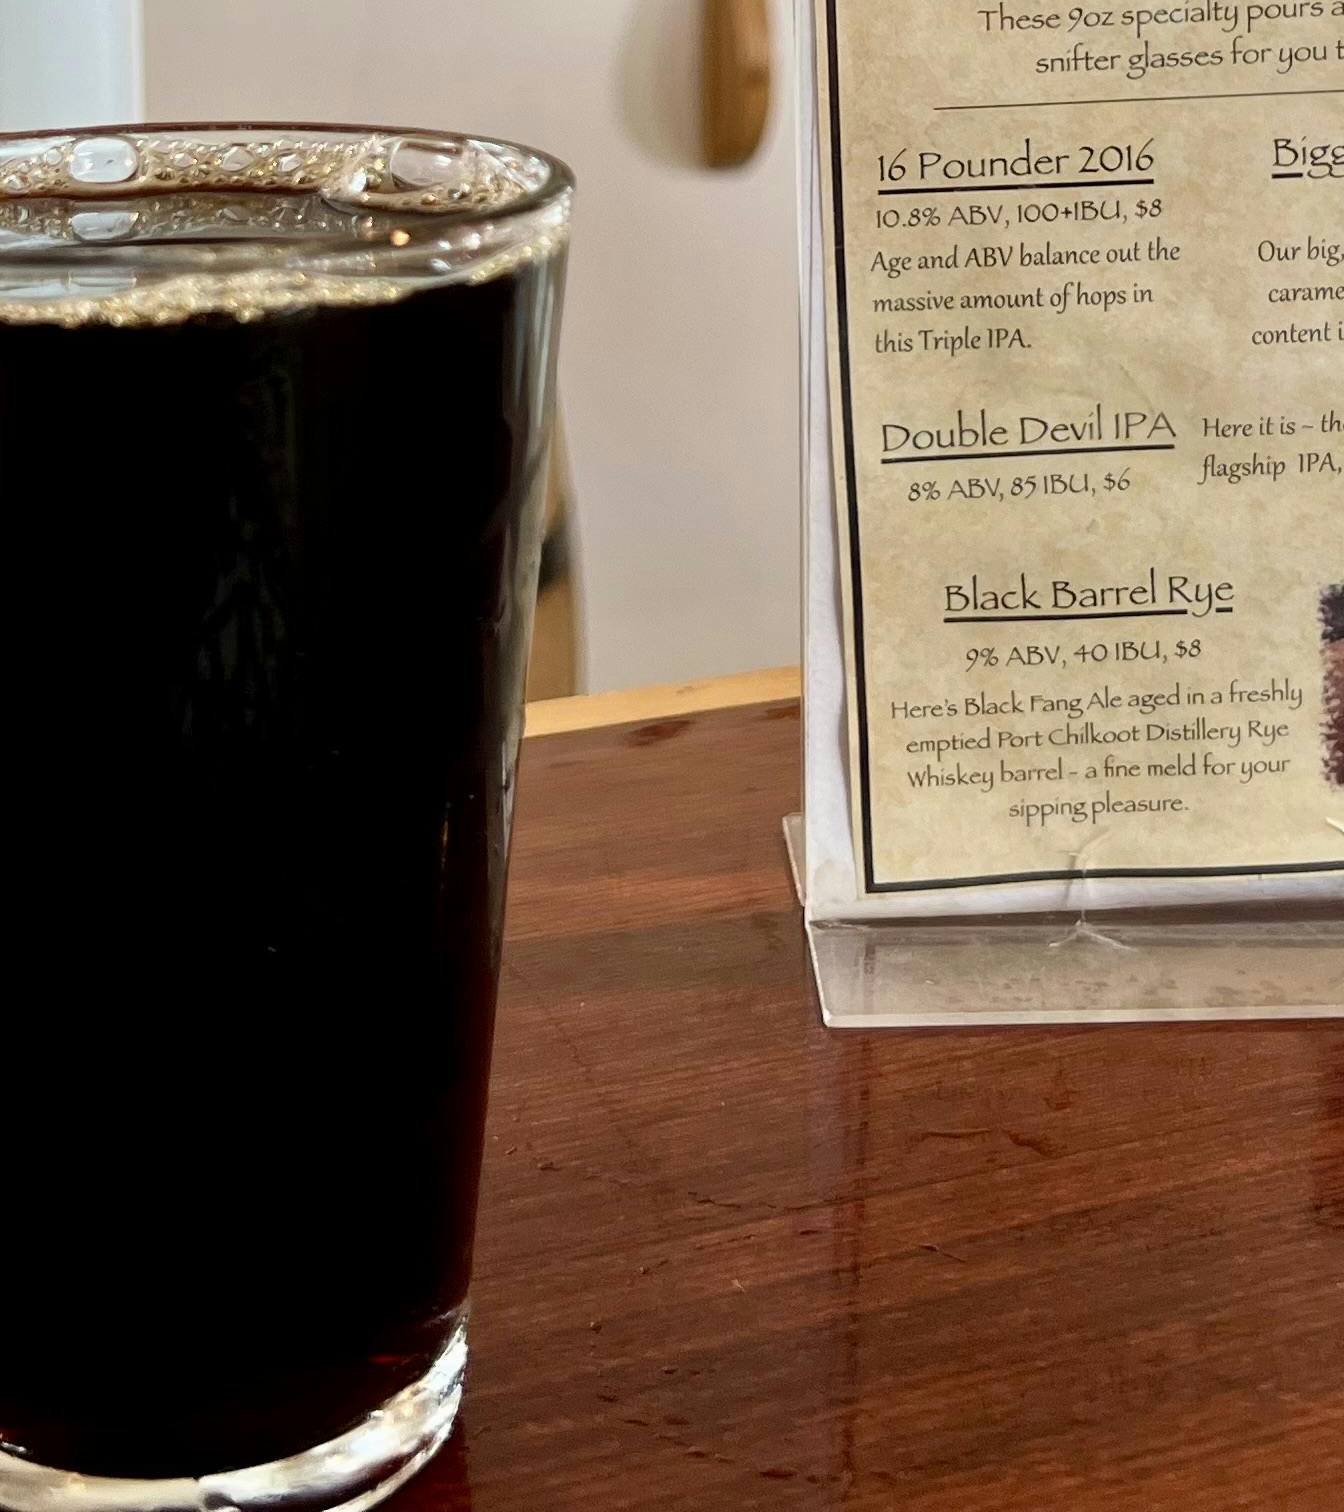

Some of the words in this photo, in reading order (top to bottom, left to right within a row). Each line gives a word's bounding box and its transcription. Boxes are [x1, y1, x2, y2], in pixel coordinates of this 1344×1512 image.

[976, 3, 1062, 32] These
[1067, 7, 1115, 33] 9oz
[1246, 1, 1324, 34] pours
[1035, 44, 1122, 74] snifter
[1125, 41, 1224, 81] glasses
[1230, 37, 1273, 65] for
[1276, 45, 1328, 75] you
[877, 147, 907, 182] 16
[918, 138, 1070, 180] Pounder
[1078, 137, 1155, 174] 2016
[876, 207, 941, 229] 10.8%
[947, 204, 1010, 229] ABV,
[1017, 199, 1128, 224] 100+IBU,
[1134, 198, 1163, 220] $8
[870, 251, 912, 279] Age
[917, 244, 959, 270] and
[964, 245, 1014, 268] ABV
[1019, 240, 1101, 267] balance
[1105, 241, 1141, 264] out
[1147, 236, 1181, 261] the
[1257, 239, 1302, 263] Our
[872, 290, 955, 313] massive
[960, 287, 1045, 309] amount
[1049, 281, 1075, 315] of
[1076, 281, 1127, 313] hops
[1133, 282, 1154, 303] in
[875, 329, 914, 354] this
[917, 325, 982, 358] Triple
[986, 327, 1032, 349] IPA.
[881, 408, 1009, 453] Double
[1019, 402, 1103, 445] Devil
[1114, 412, 1177, 440] IPA
[907, 480, 941, 503] 8%
[947, 477, 1004, 502] ABV,
[1010, 475, 1037, 499] 85
[1043, 473, 1096, 497] IBU,
[1103, 467, 1131, 492] $6
[944, 572, 1042, 612] Black
[1051, 566, 1157, 610] Barrel
[1168, 575, 1235, 618] Rye
[965, 647, 999, 673] 9%
[1005, 645, 1067, 669] ABV,
[1073, 643, 1109, 663] 40
[1115, 640, 1168, 664] IBU,
[1174, 638, 1202, 659] $8
